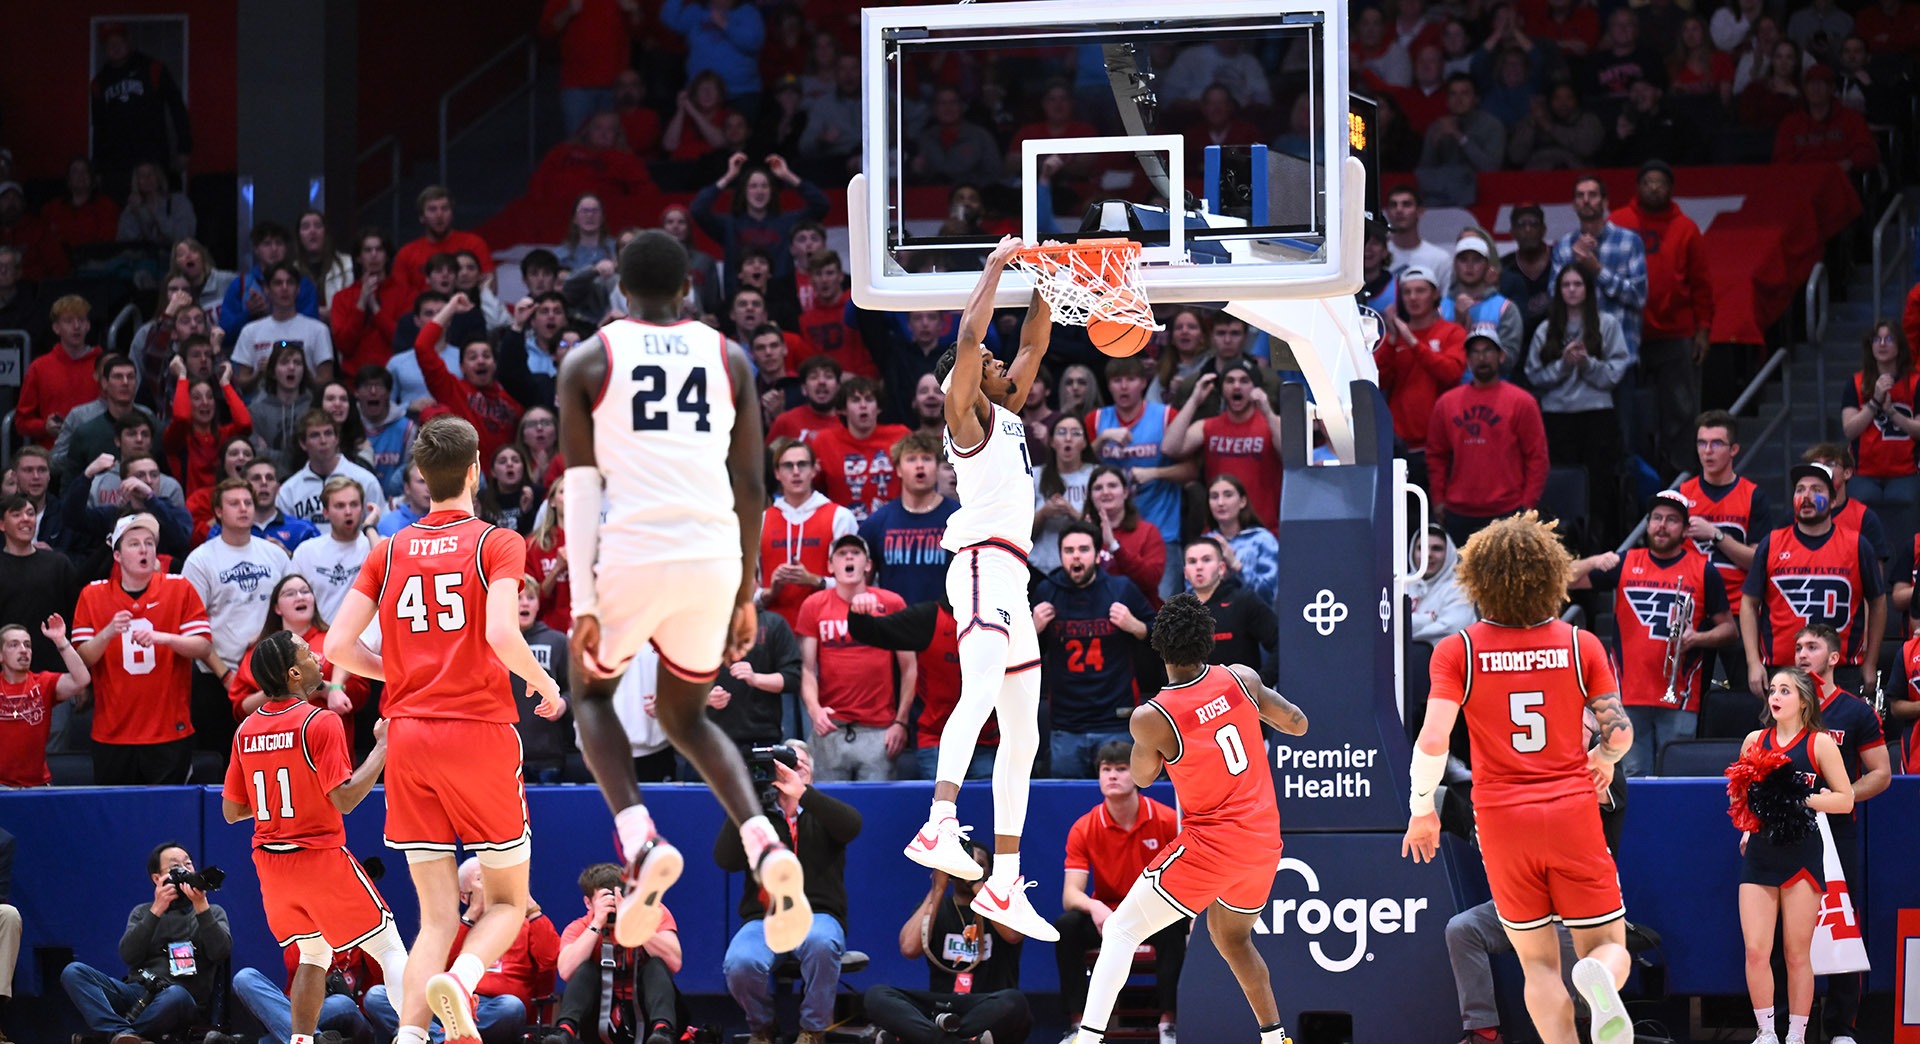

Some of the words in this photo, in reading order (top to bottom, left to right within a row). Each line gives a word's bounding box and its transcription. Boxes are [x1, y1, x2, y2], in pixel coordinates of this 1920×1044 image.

[643, 333, 689, 356] ELVIS
[632, 364, 711, 432] 24
[1209, 435, 1264, 454] FLYERS
[374, 451, 401, 467] TON
[408, 535, 459, 556] DYNES
[884, 534, 946, 566] DAYTON
[219, 563, 272, 584] SPOTLIGHT
[1626, 579, 1660, 588] DAYTON
[1774, 566, 1811, 575] DAYTON
[1814, 566, 1851, 575] FLYERS
[397, 571, 467, 633] 45
[1065, 637, 1105, 673] 24
[1478, 648, 1569, 672] THOMPSON
[1195, 694, 1232, 725] RUSH
[1508, 690, 1548, 755] 5
[243, 732, 294, 753] LANGDON
[1214, 722, 1250, 777] 0
[1276, 743, 1378, 769] Premier
[253, 766, 296, 821] 11
[1284, 771, 1371, 798] Health
